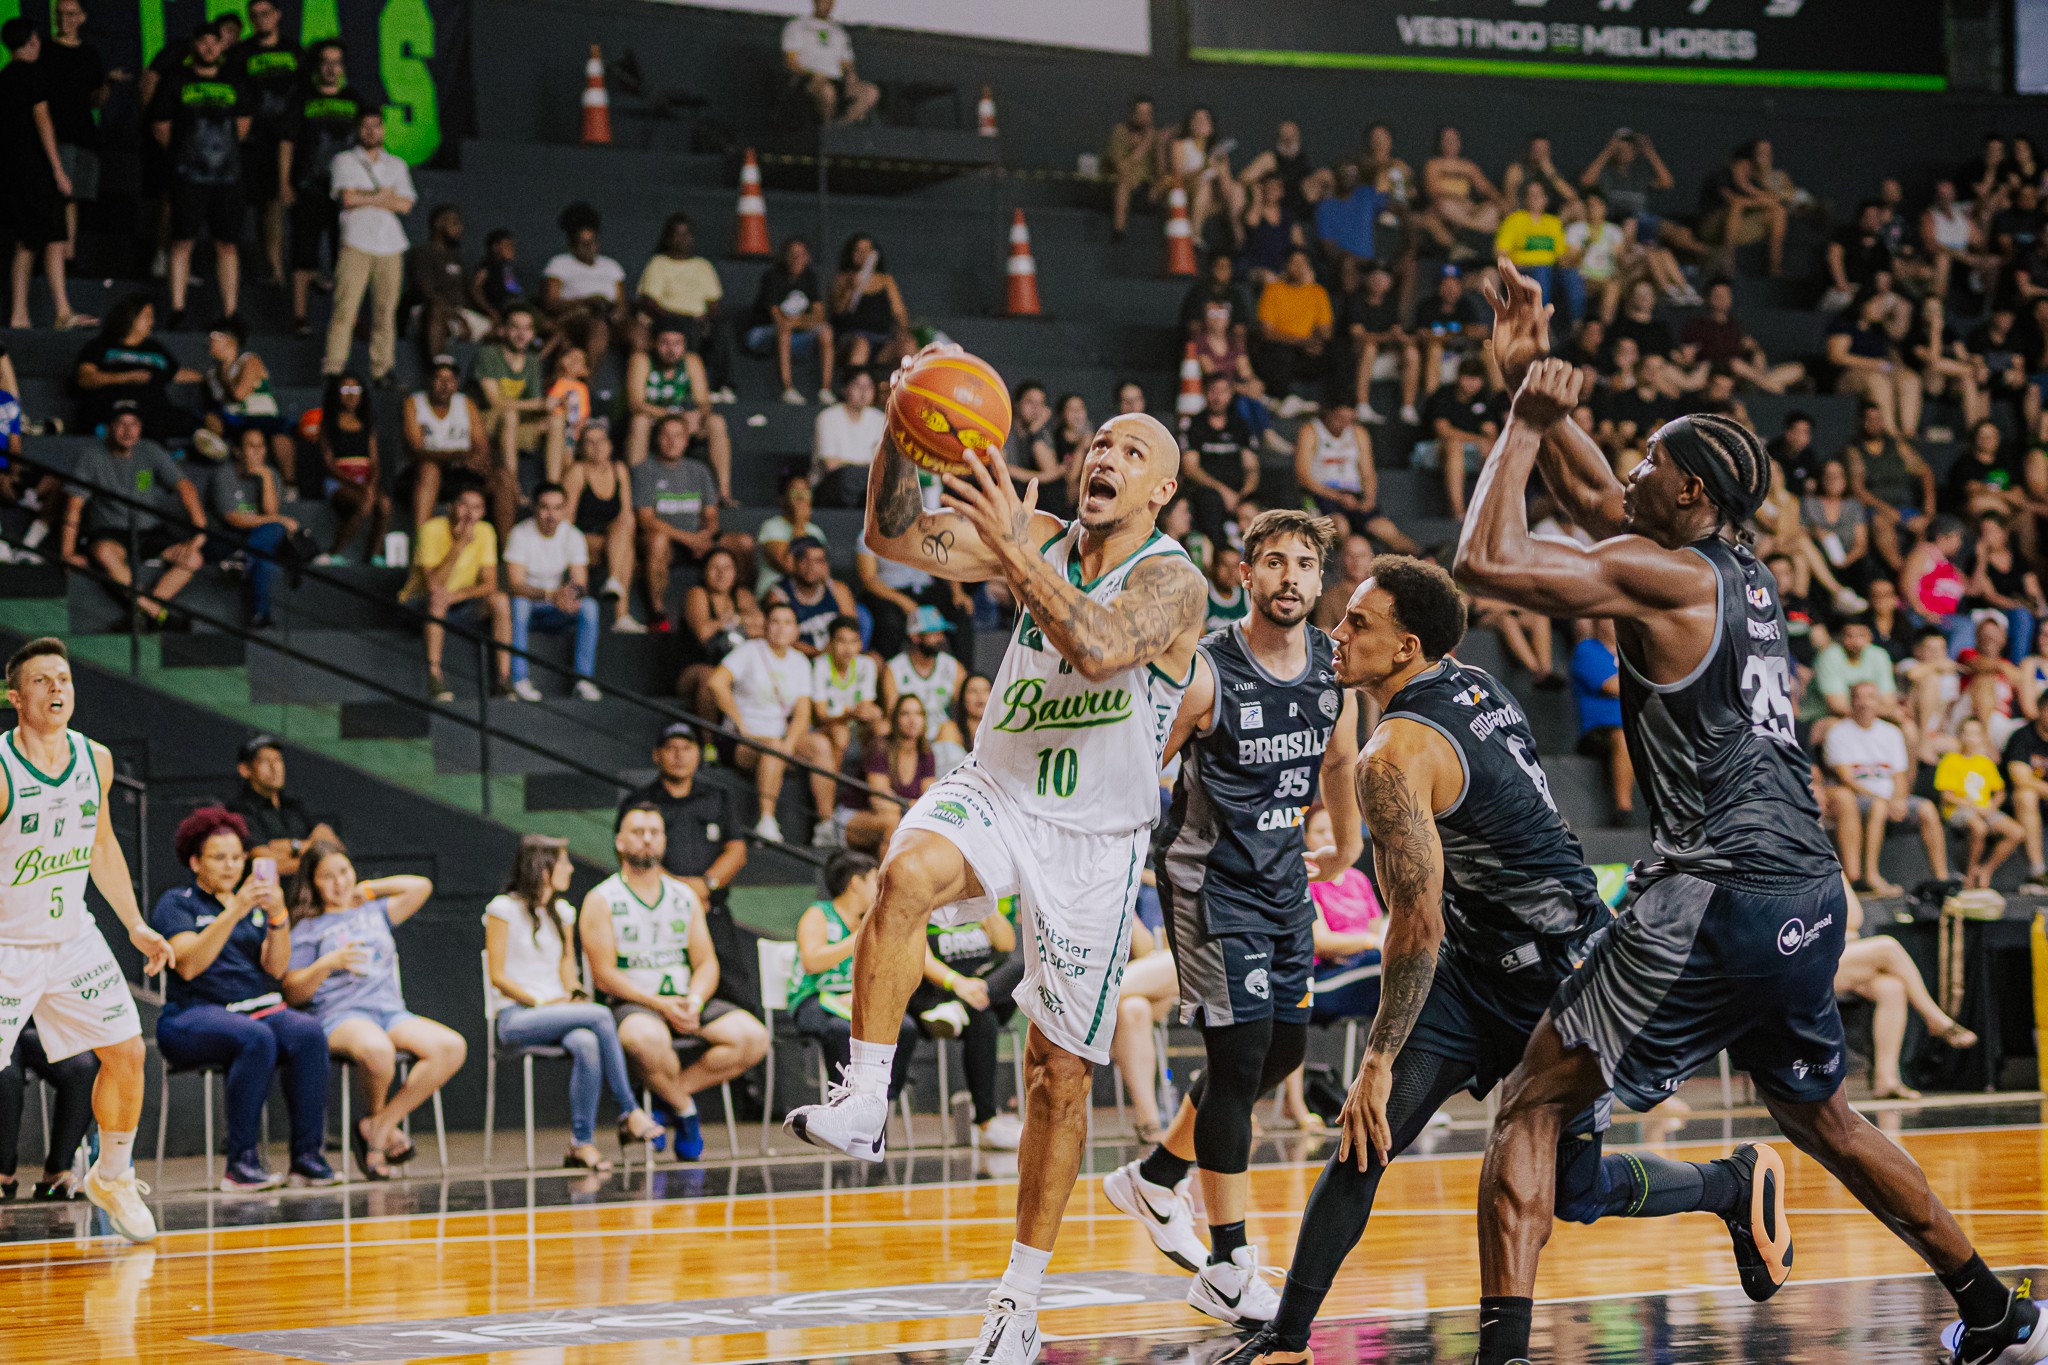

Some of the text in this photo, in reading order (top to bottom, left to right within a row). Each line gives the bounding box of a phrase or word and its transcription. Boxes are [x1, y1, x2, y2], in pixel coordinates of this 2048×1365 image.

[1396, 15, 1546, 52] VESTINDO
[1583, 25, 1758, 61] MELHORES
[993, 678, 1133, 733] Bauru
[1233, 681, 1258, 692] JADE
[1037, 747, 1079, 798] 10
[1273, 766, 1312, 799] 35
[10, 844, 93, 887] Bauru
[49, 886, 64, 919] 5
